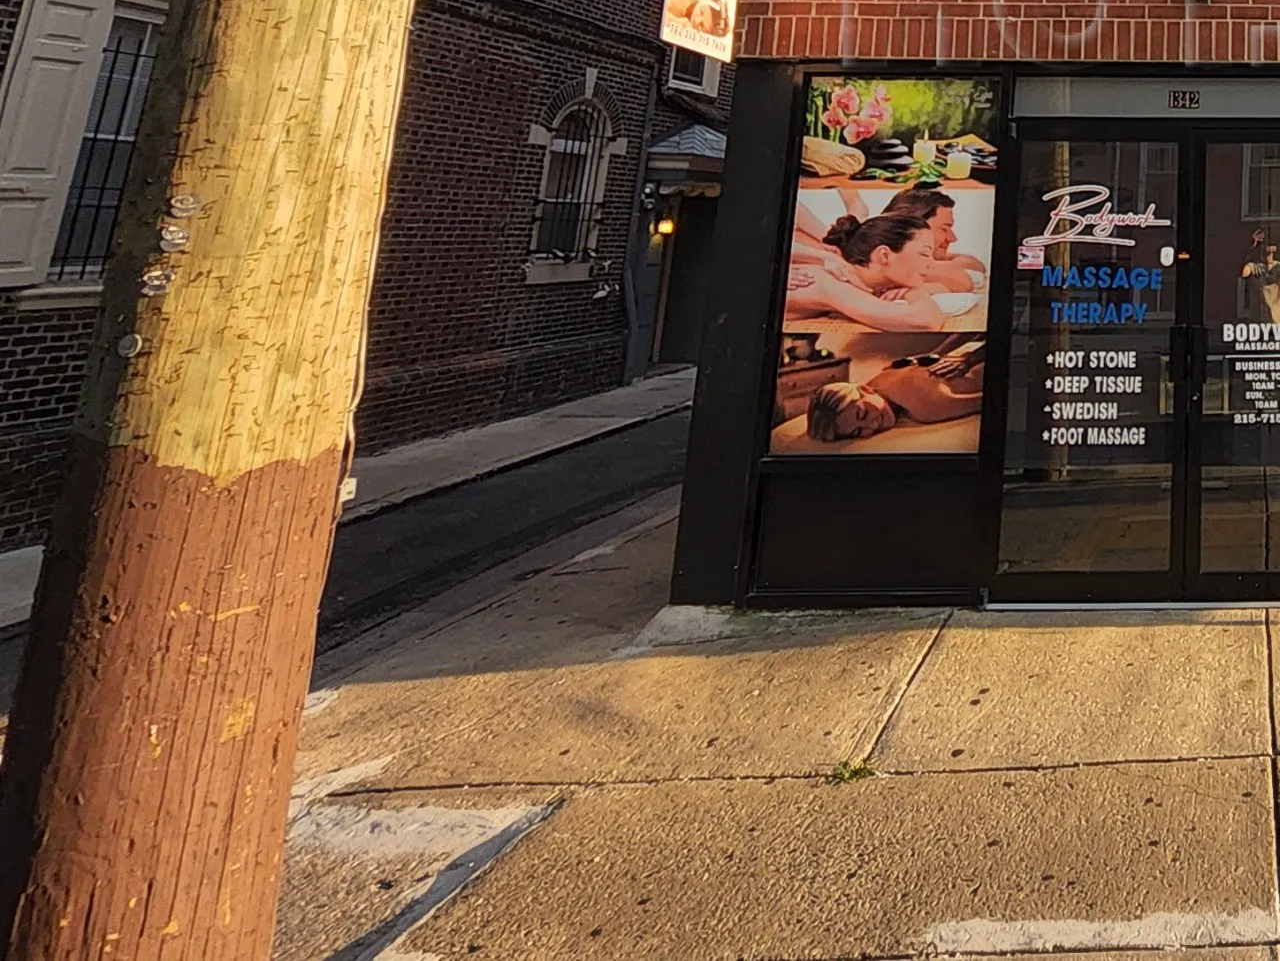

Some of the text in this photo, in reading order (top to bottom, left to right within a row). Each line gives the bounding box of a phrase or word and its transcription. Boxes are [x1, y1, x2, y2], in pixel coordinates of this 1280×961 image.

[1169, 91, 1199, 108] 1342
[1022, 184, 1171, 246] Bodywork
[1042, 265, 1163, 291] MASSAGE
[1050, 301, 1147, 325] THERAPY
[1235, 342, 1280, 351] MASSAGE
[1054, 351, 1137, 369] HOT STONE
[1235, 361, 1280, 371] BUSINESS
[1053, 376, 1143, 393] DEEP TISSUE
[1252, 382, 1275, 390] 10AM
[1052, 402, 1118, 420] SWEDISH
[1255, 400, 1278, 409] 10AM
[1050, 427, 1146, 445] FOOT MASSAGE
